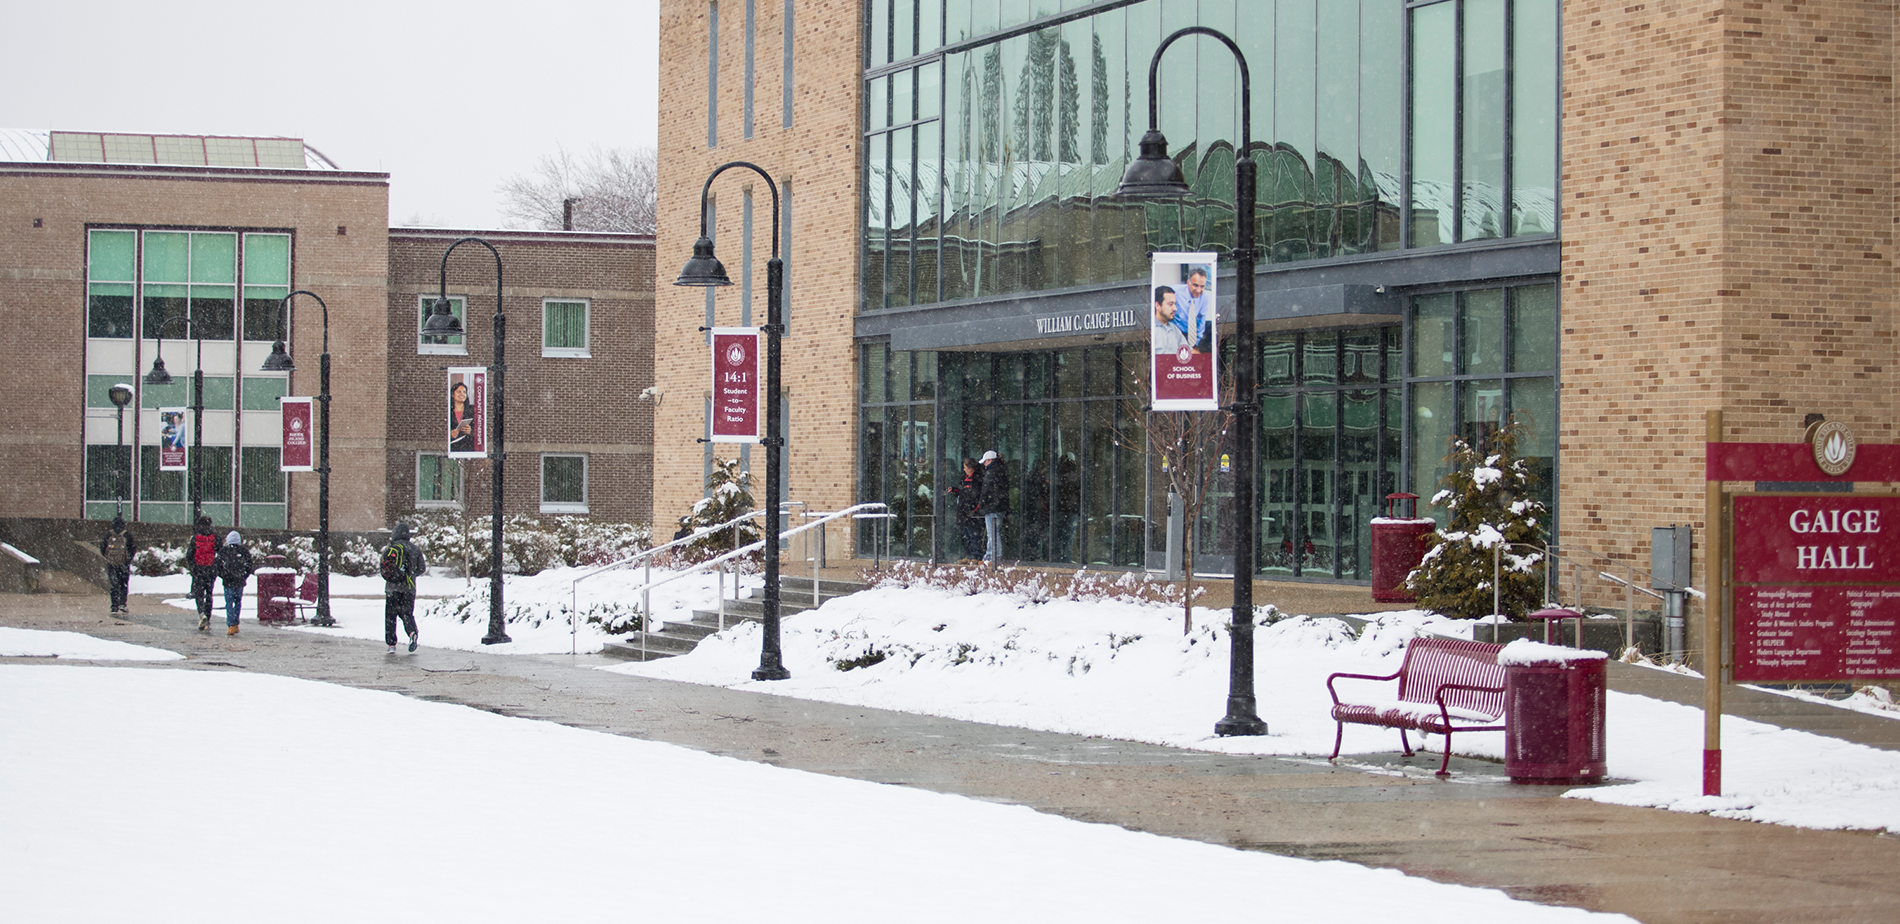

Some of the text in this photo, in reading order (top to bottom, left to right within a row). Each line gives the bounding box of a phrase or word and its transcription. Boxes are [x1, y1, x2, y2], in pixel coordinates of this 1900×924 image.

[1036, 315, 1072, 334] WILLIAM
[1084, 312, 1111, 329] GAIGE
[1112, 310, 1136, 327] HALL
[724, 371, 747, 382] 14:1
[724, 406, 747, 414] Faculty
[1789, 509, 1881, 533] GAIGE
[1796, 545, 1874, 569] HALL
[1757, 591, 1812, 599] Anthropology Department
[1850, 600, 1873, 609] Geography
[1761, 610, 1773, 619] Study
[1815, 620, 1834, 628] Program
[1846, 629, 1892, 638] Sociology Department
[1850, 639, 1864, 647] Justice
[1774, 649, 1794, 657] Language
[1796, 649, 1821, 657] Department
[1757, 658, 1806, 667] Philosophy Department
